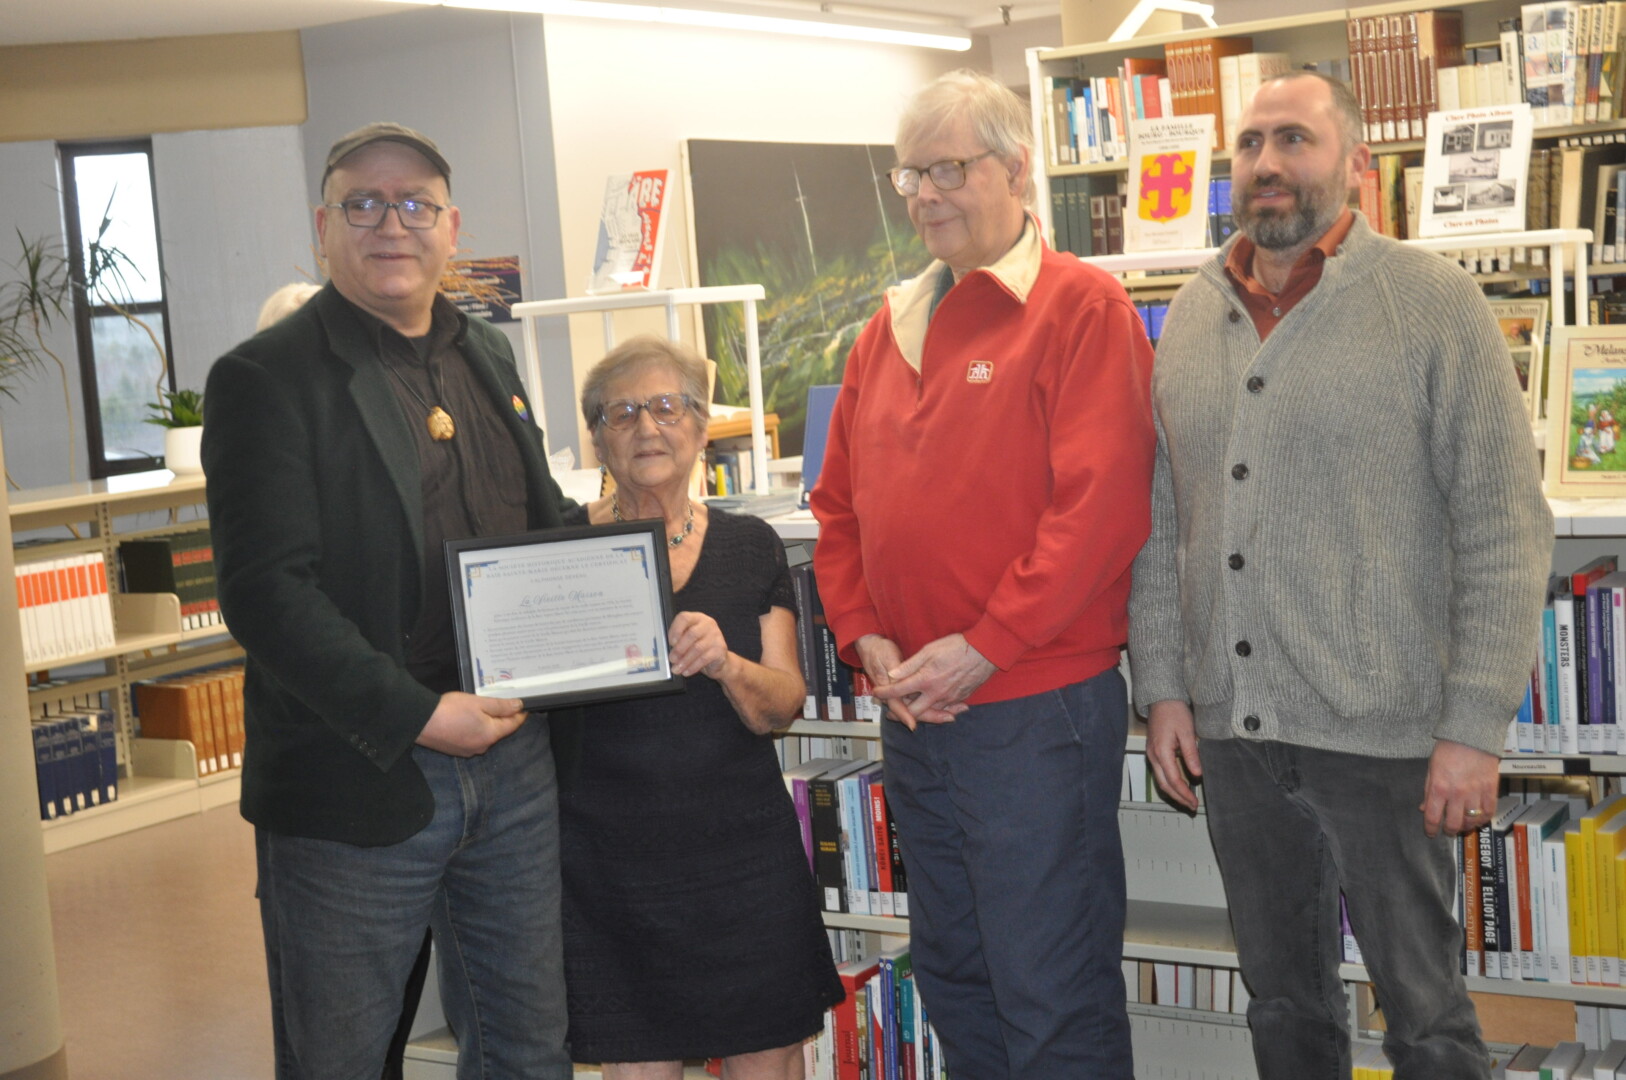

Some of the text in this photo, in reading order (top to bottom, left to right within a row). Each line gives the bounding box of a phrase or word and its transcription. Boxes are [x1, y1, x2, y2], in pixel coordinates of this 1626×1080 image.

[1490, 109, 1514, 117] Album
[1507, 305, 1539, 316] Album
[1559, 624, 1570, 668] MONSTERS
[874, 796, 883, 822] MOINS!
[1496, 837, 1504, 865] ANTONY
[1466, 857, 1474, 908] NIETZSCHE
[1479, 827, 1496, 944] PAGEBOY ELLIOT PAGE
